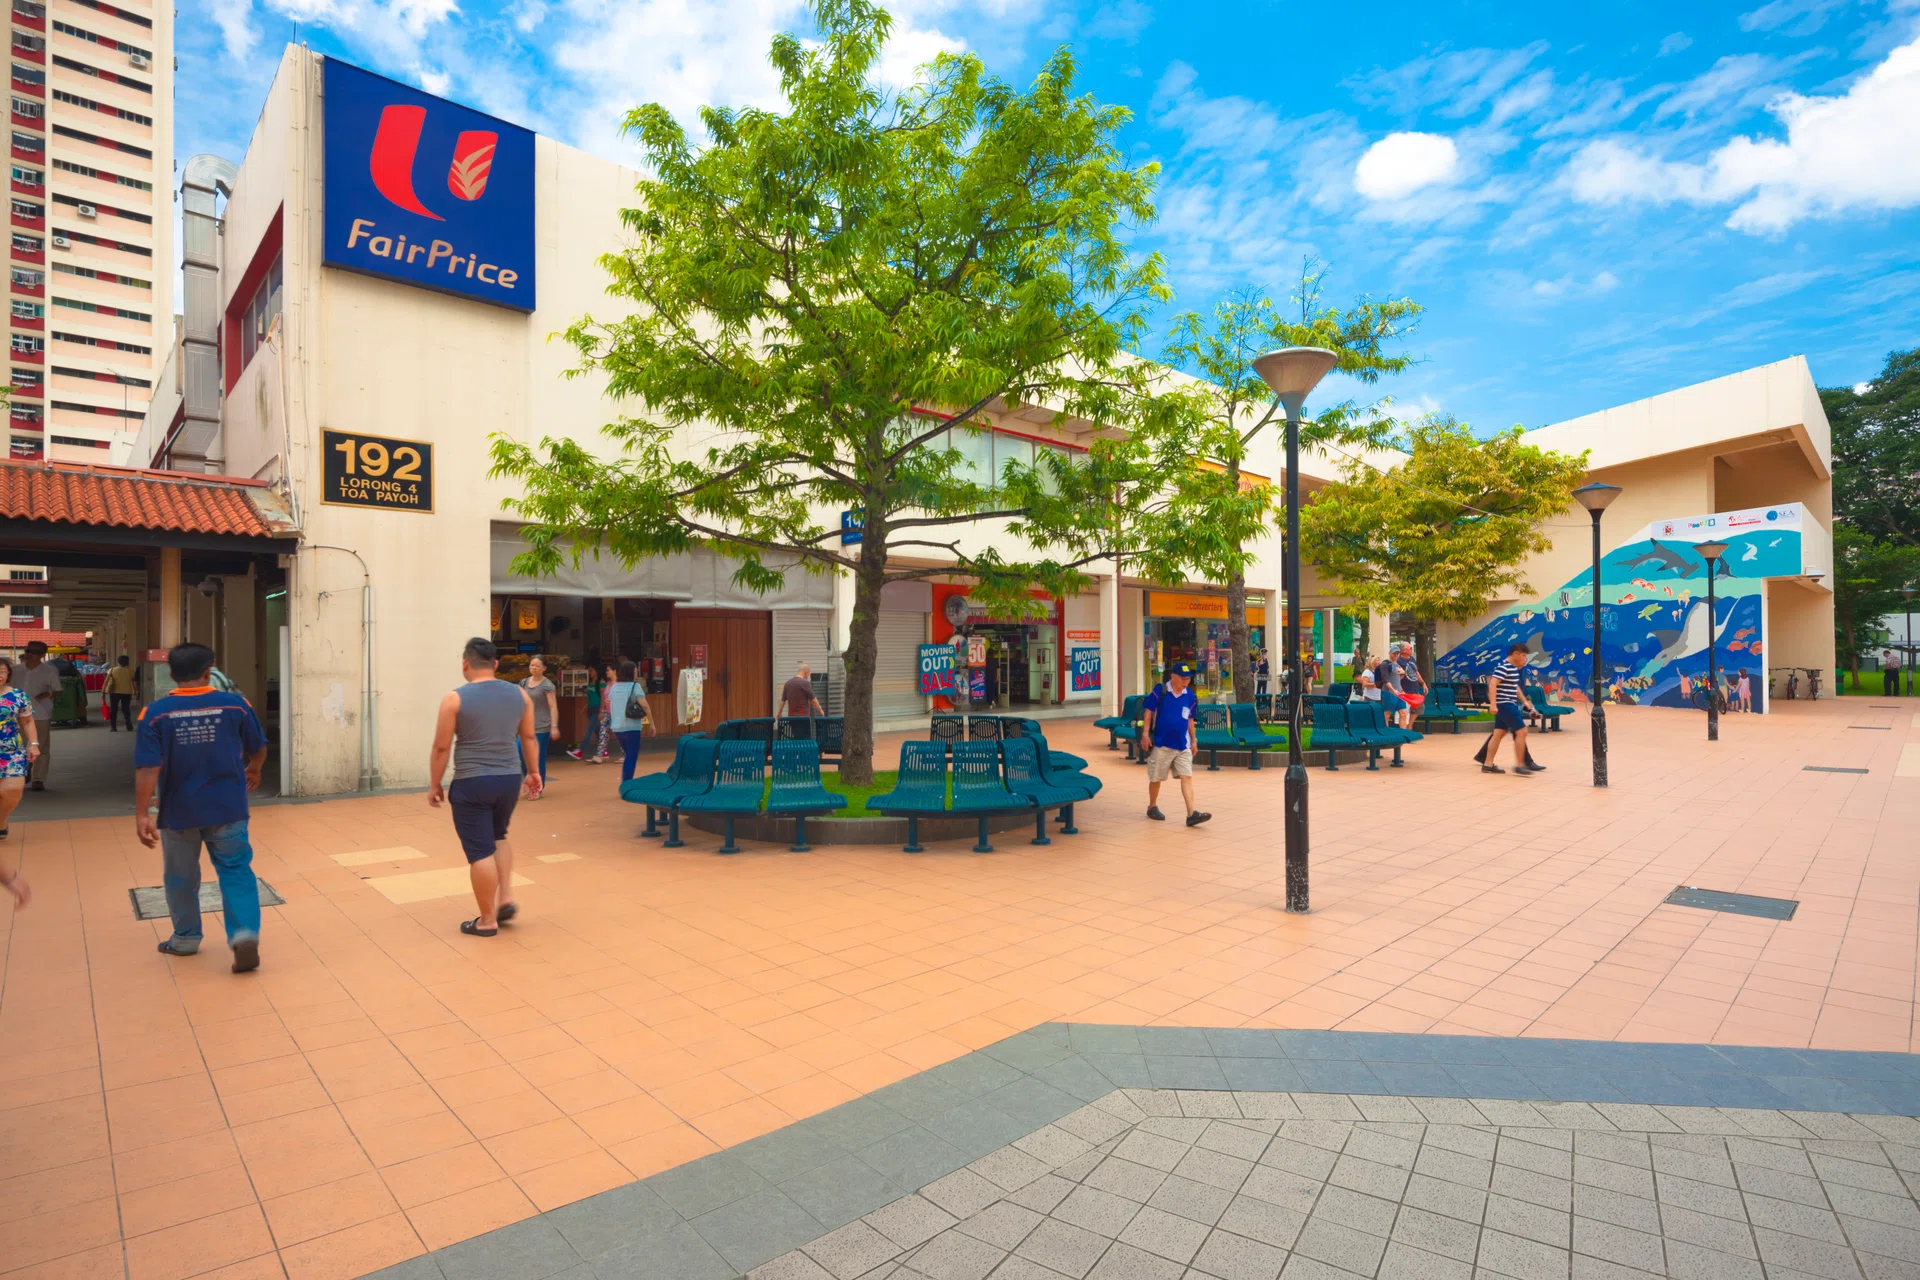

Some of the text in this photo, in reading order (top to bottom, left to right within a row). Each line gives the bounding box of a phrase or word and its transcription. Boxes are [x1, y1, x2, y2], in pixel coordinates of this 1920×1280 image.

[347, 218, 519, 289] FairPrice
[335, 439, 422, 481] 192
[340, 476, 417, 494] LORONG 4
[339, 487, 419, 504] TOA PAYOH
[921, 646, 954, 657] MOVING
[968, 643, 986, 663] 50
[922, 656, 949, 672] OUT
[1079, 658, 1100, 675] OUT
[921, 669, 954, 694] SALE
[1075, 671, 1101, 690] SALE
